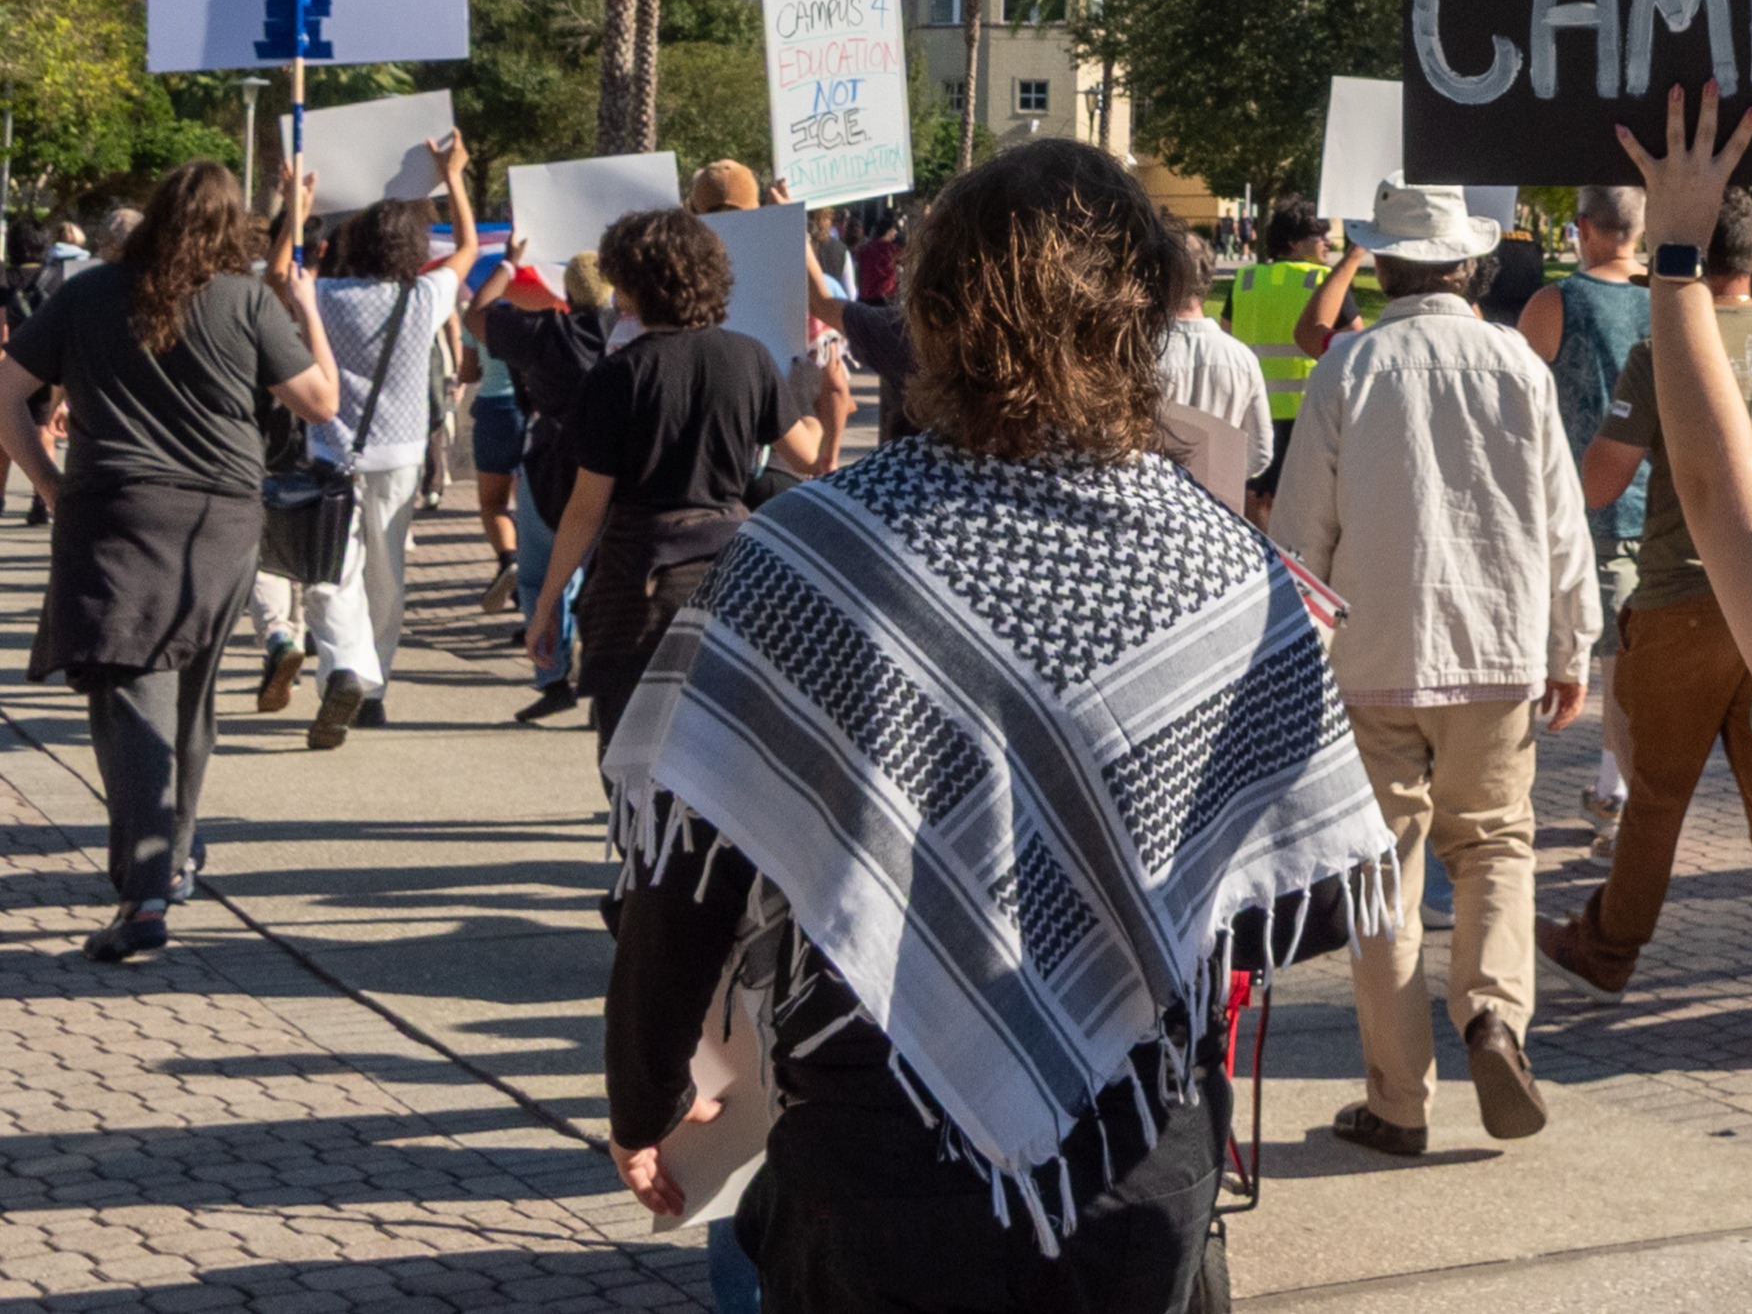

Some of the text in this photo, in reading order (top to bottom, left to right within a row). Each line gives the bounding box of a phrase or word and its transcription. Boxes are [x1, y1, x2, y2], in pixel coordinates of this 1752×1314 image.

[777, 37, 900, 88] EDUCATION
[812, 77, 866, 114] NOT
[784, 142, 907, 188] INTIMIDATION
